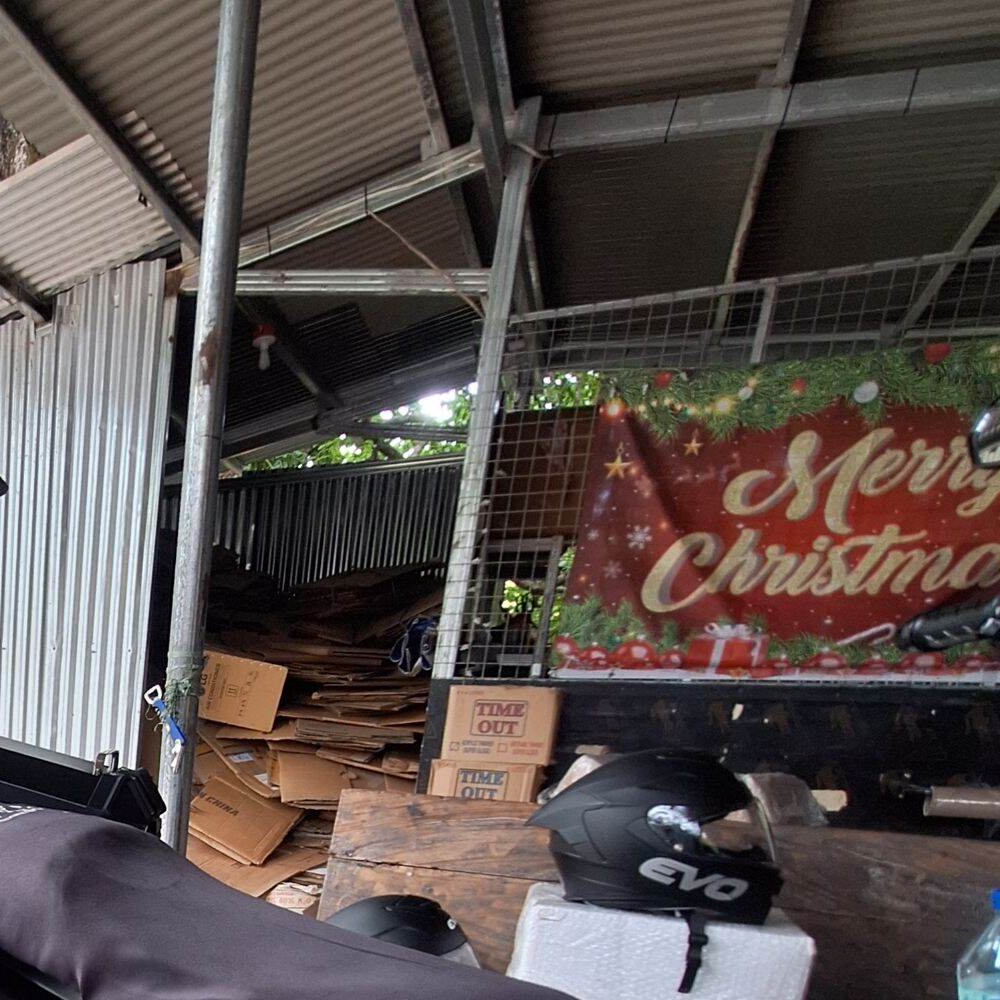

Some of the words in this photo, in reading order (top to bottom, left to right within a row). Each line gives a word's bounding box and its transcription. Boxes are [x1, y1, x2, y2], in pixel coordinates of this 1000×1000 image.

[476, 702, 525, 717] TIME
[477, 720, 519, 735] OUT
[460, 770, 504, 786] TIME
[461, 786, 499, 799] OUT
[638, 856, 749, 901] EVO
